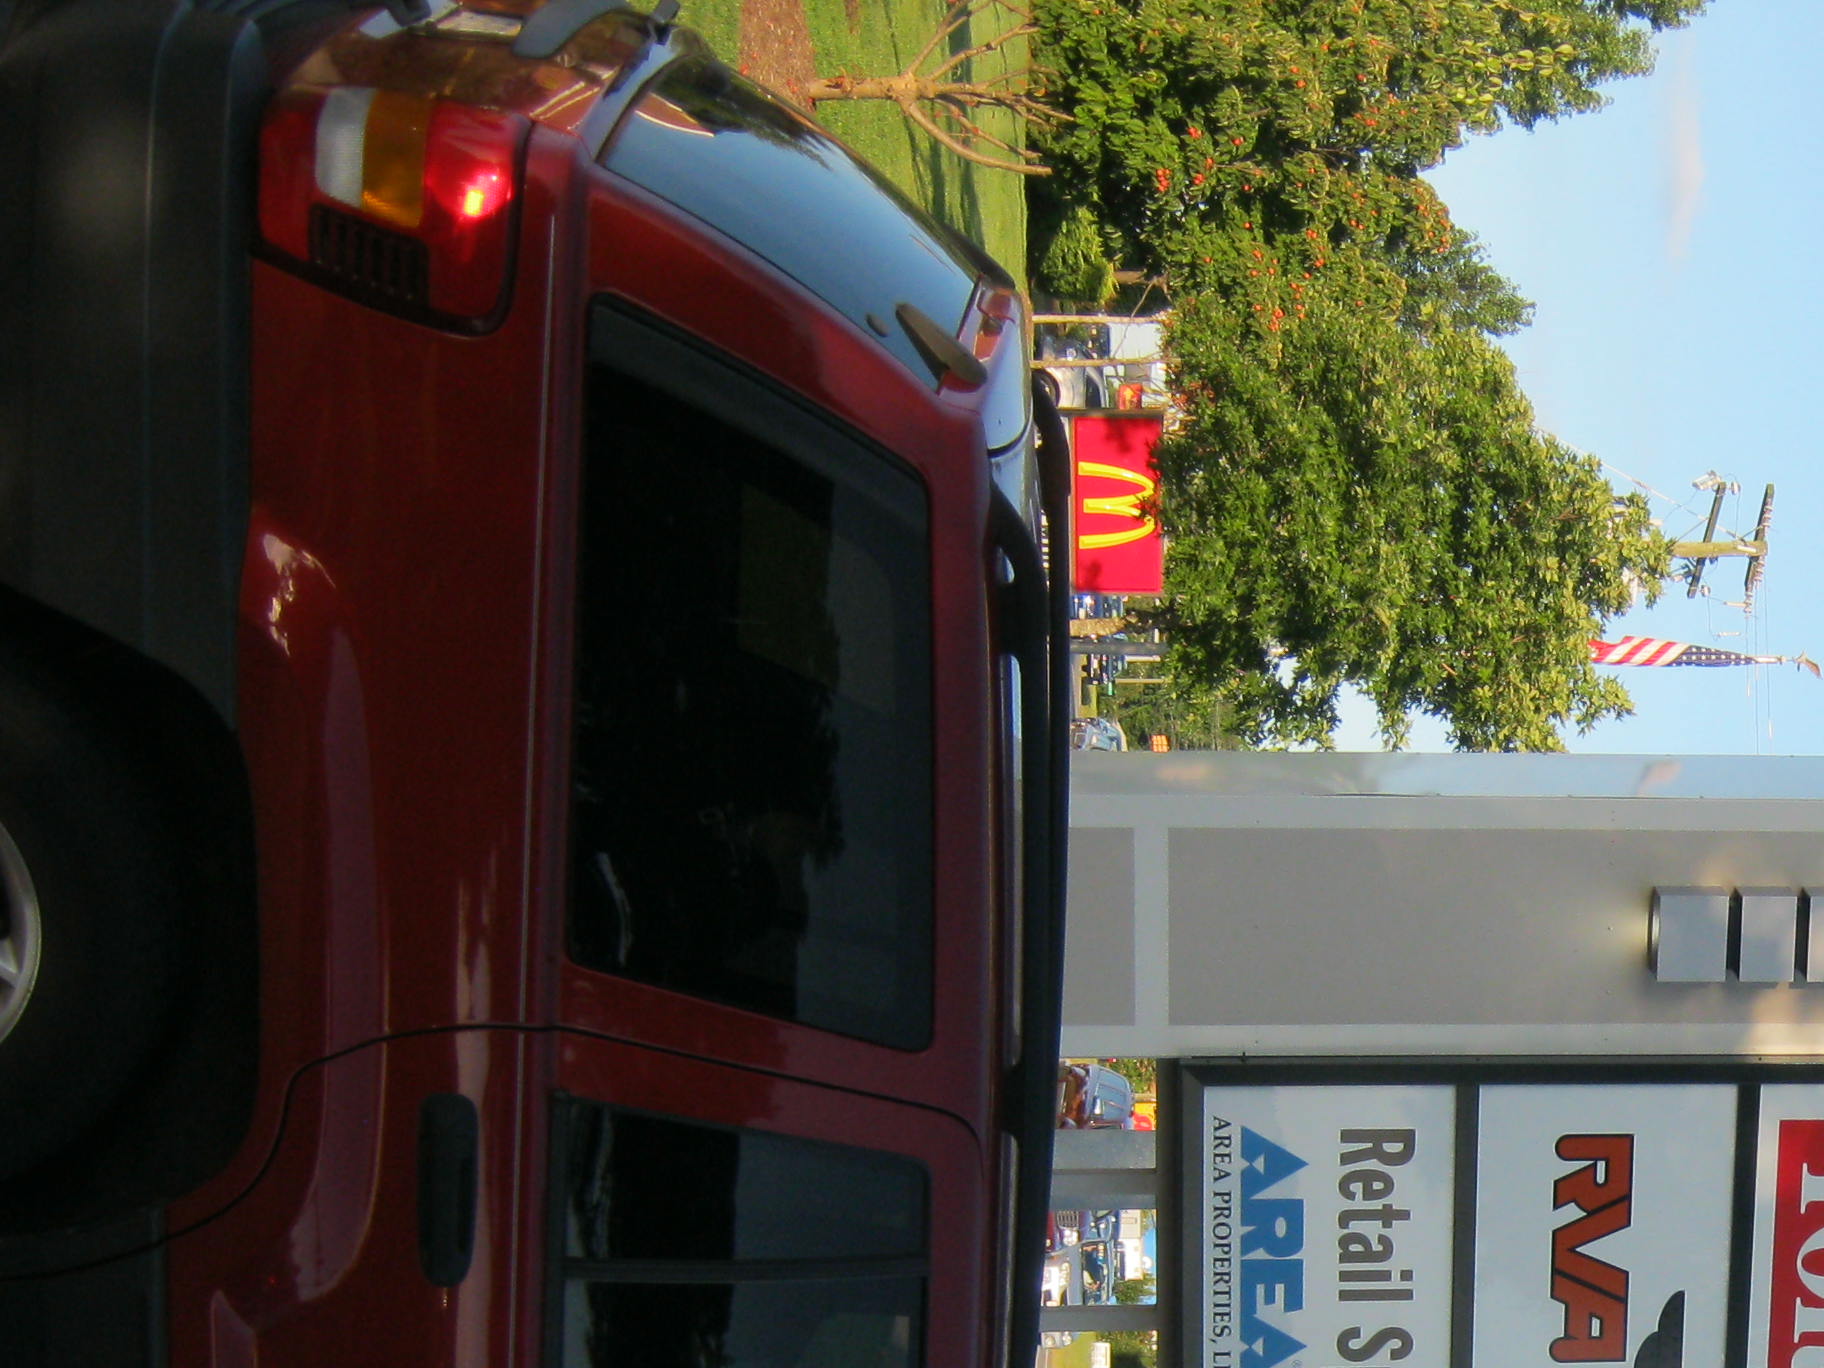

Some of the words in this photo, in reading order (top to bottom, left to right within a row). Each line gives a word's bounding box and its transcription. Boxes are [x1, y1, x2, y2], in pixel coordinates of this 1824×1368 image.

[1212, 1115, 1232, 1182] AREA
[1337, 1128, 1416, 1302] Retail
[1209, 1191, 1232, 1345] PROPERTIES,
